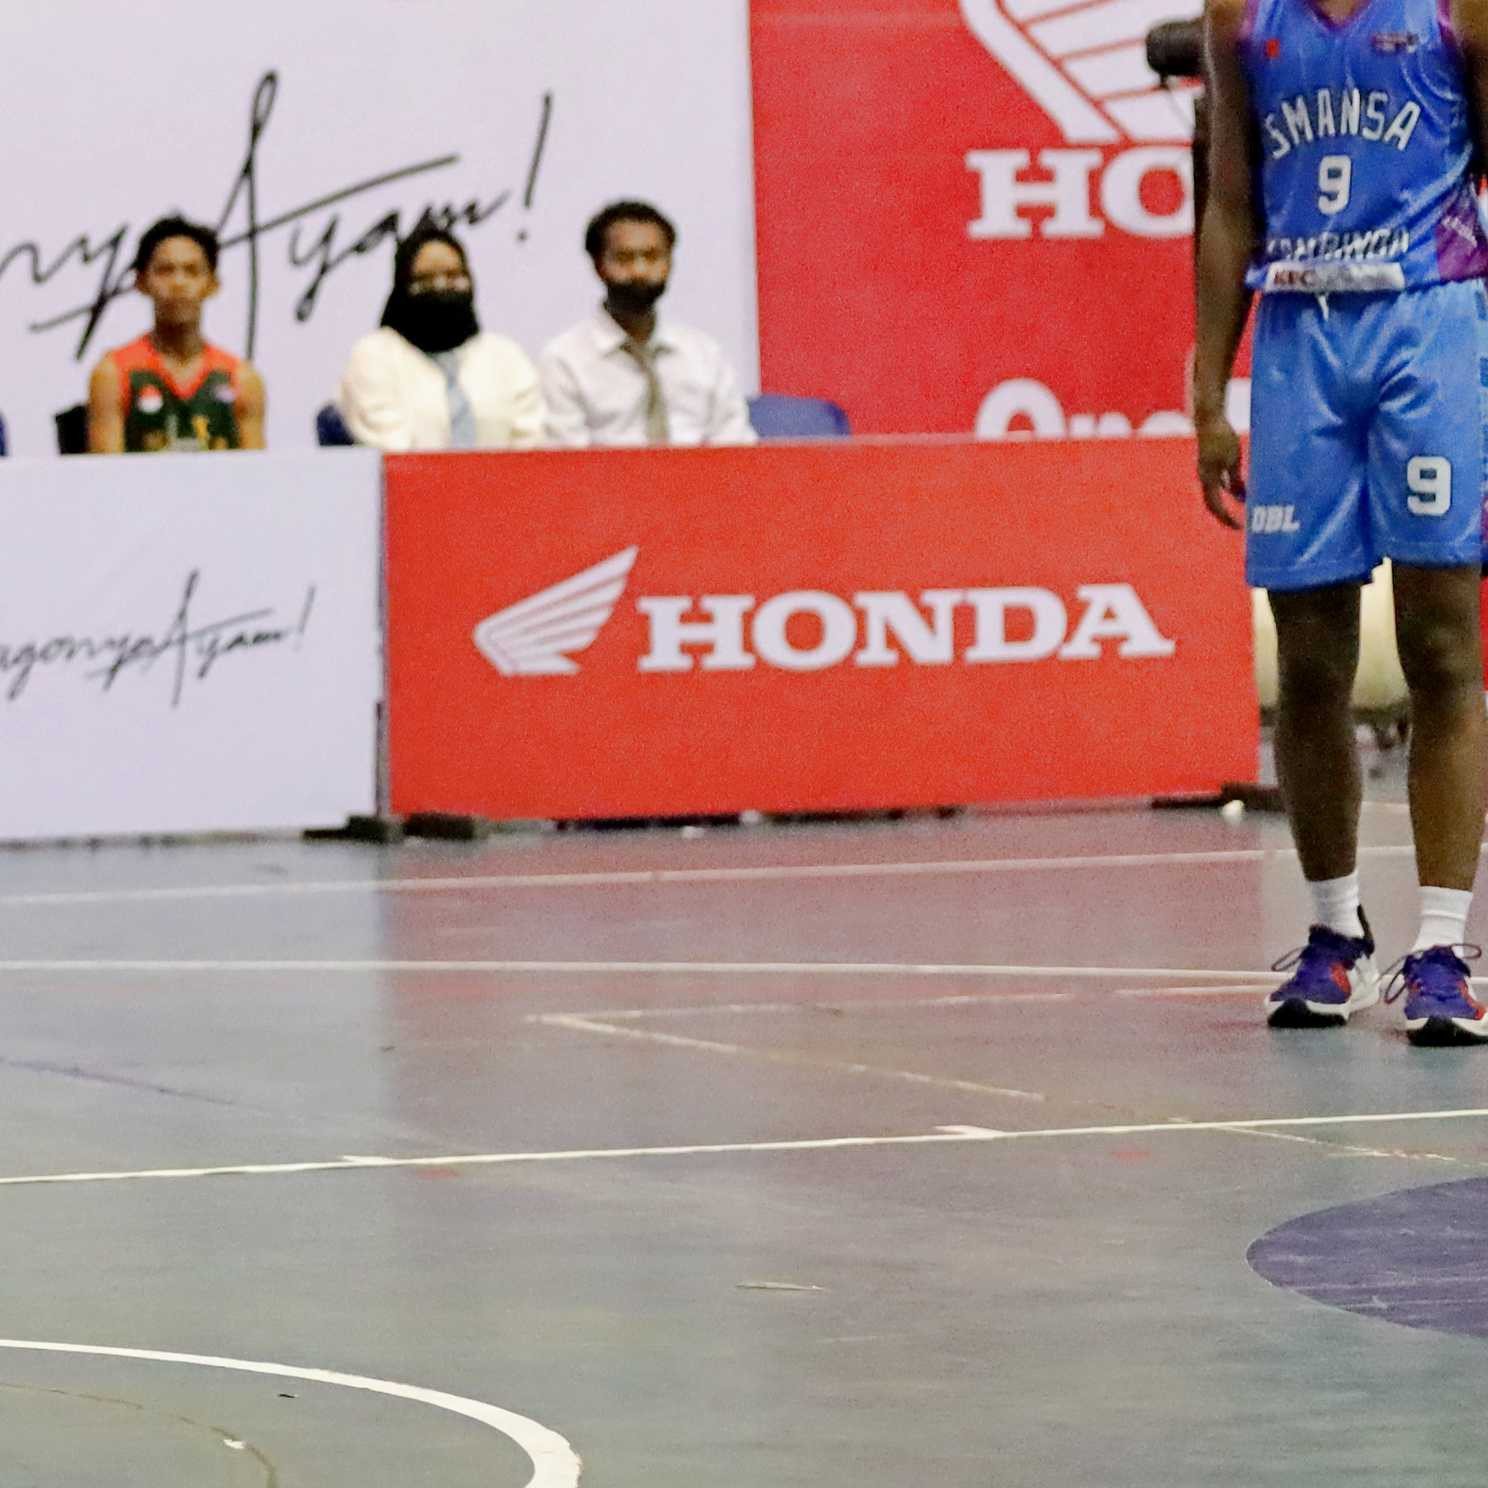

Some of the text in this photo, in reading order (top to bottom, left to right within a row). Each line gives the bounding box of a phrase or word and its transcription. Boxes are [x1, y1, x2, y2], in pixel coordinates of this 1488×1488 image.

[1264, 86, 1422, 161] SMANSA
[1317, 154, 1353, 216] 9
[1406, 455, 1452, 517] 9
[1250, 504, 1300, 534] DBL
[635, 582, 1176, 674] HONDA
